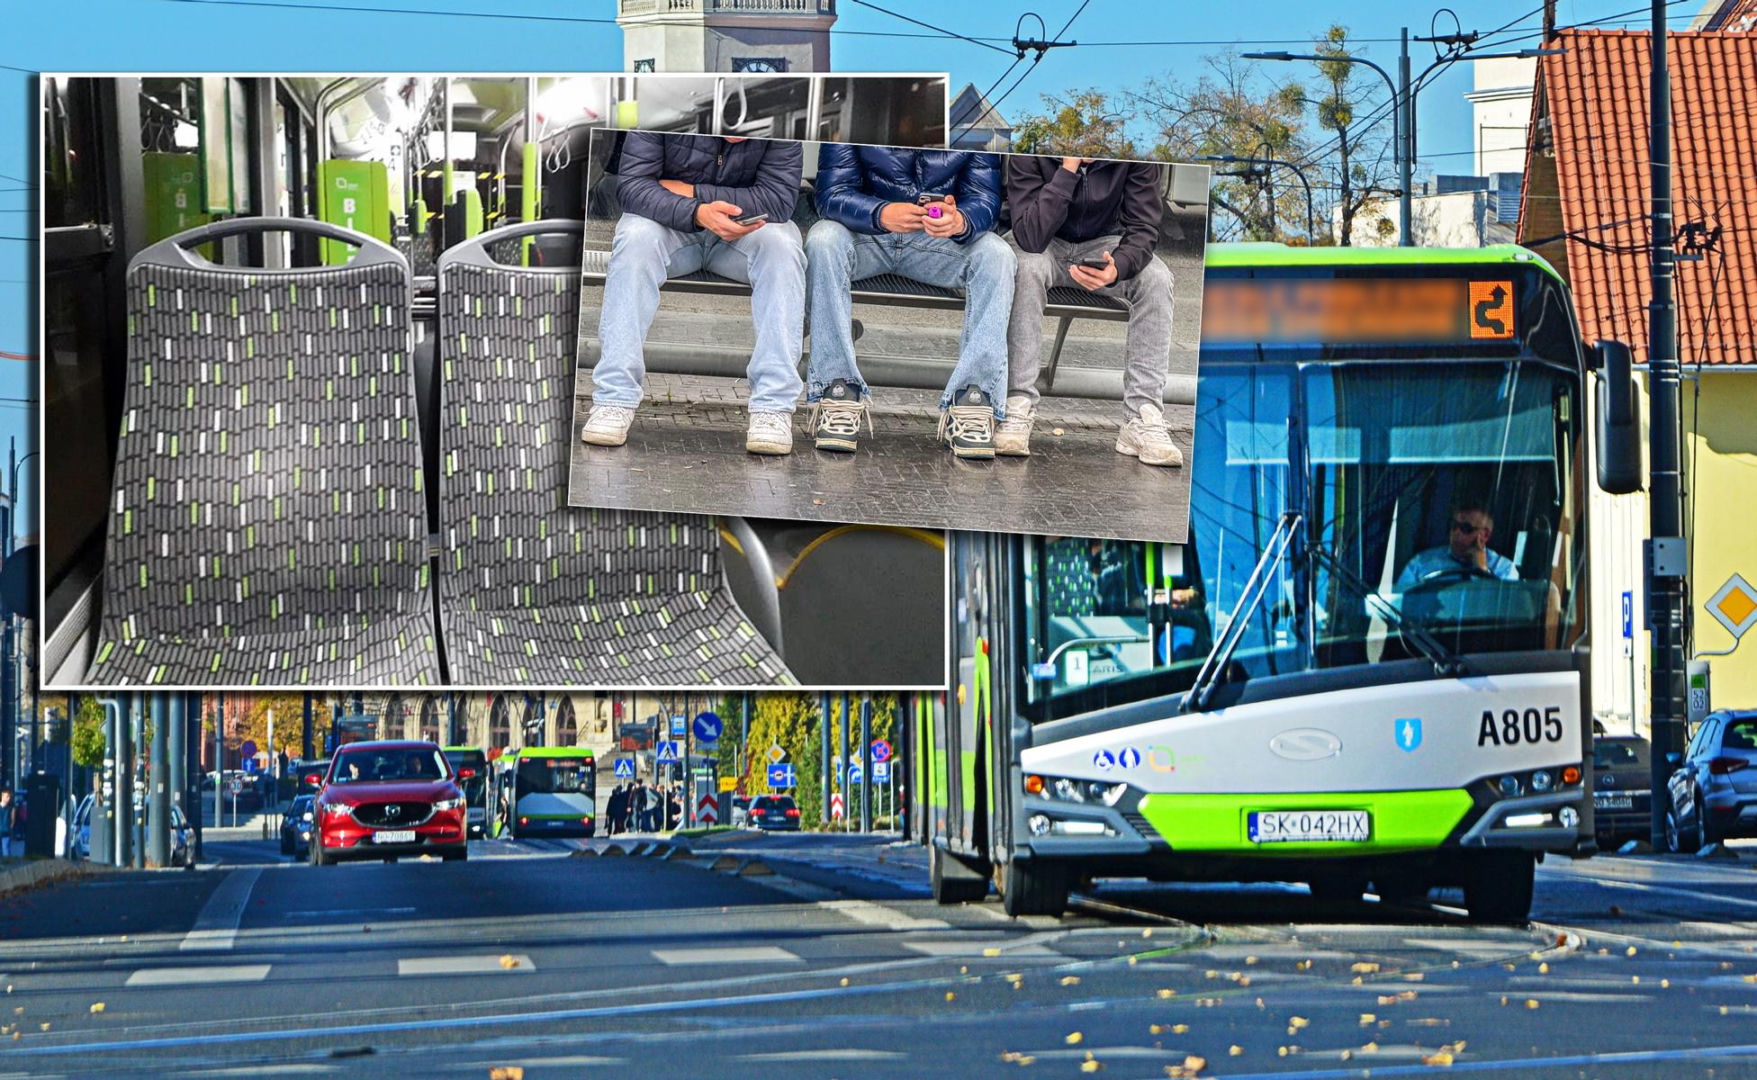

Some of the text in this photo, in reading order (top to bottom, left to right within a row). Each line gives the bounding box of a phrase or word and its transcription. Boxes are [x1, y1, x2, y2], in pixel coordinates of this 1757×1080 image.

[1477, 706, 1563, 747] A805
[1263, 813, 1364, 835] SK 042HX
